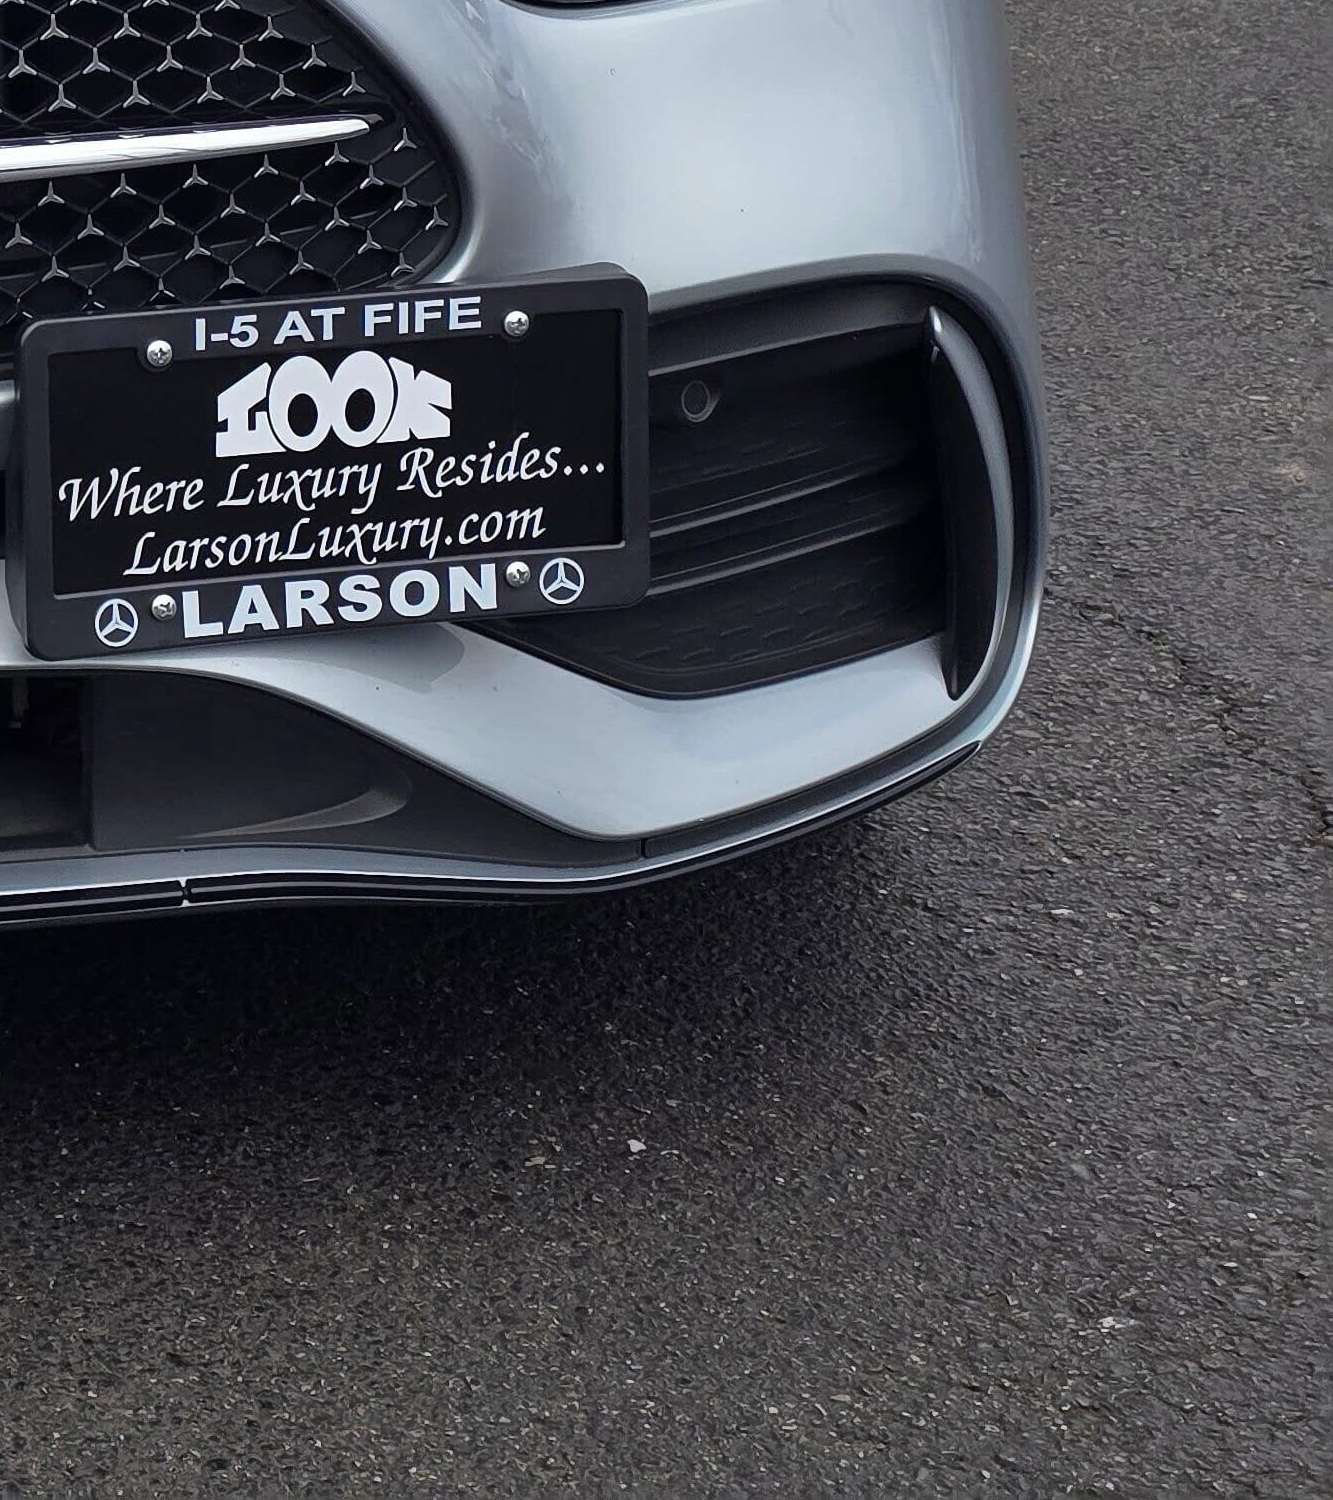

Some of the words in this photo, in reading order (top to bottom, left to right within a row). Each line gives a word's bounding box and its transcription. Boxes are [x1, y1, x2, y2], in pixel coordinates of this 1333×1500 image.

[195, 314, 259, 350] I-5
[273, 306, 345, 345] AT
[363, 296, 482, 337] FIFE
[58, 466, 205, 521] Where
[217, 462, 382, 514] Luxury
[396, 431, 605, 498] Resides...
[123, 506, 547, 576] LarsonLuxury.com
[182, 563, 498, 639] LARSON
